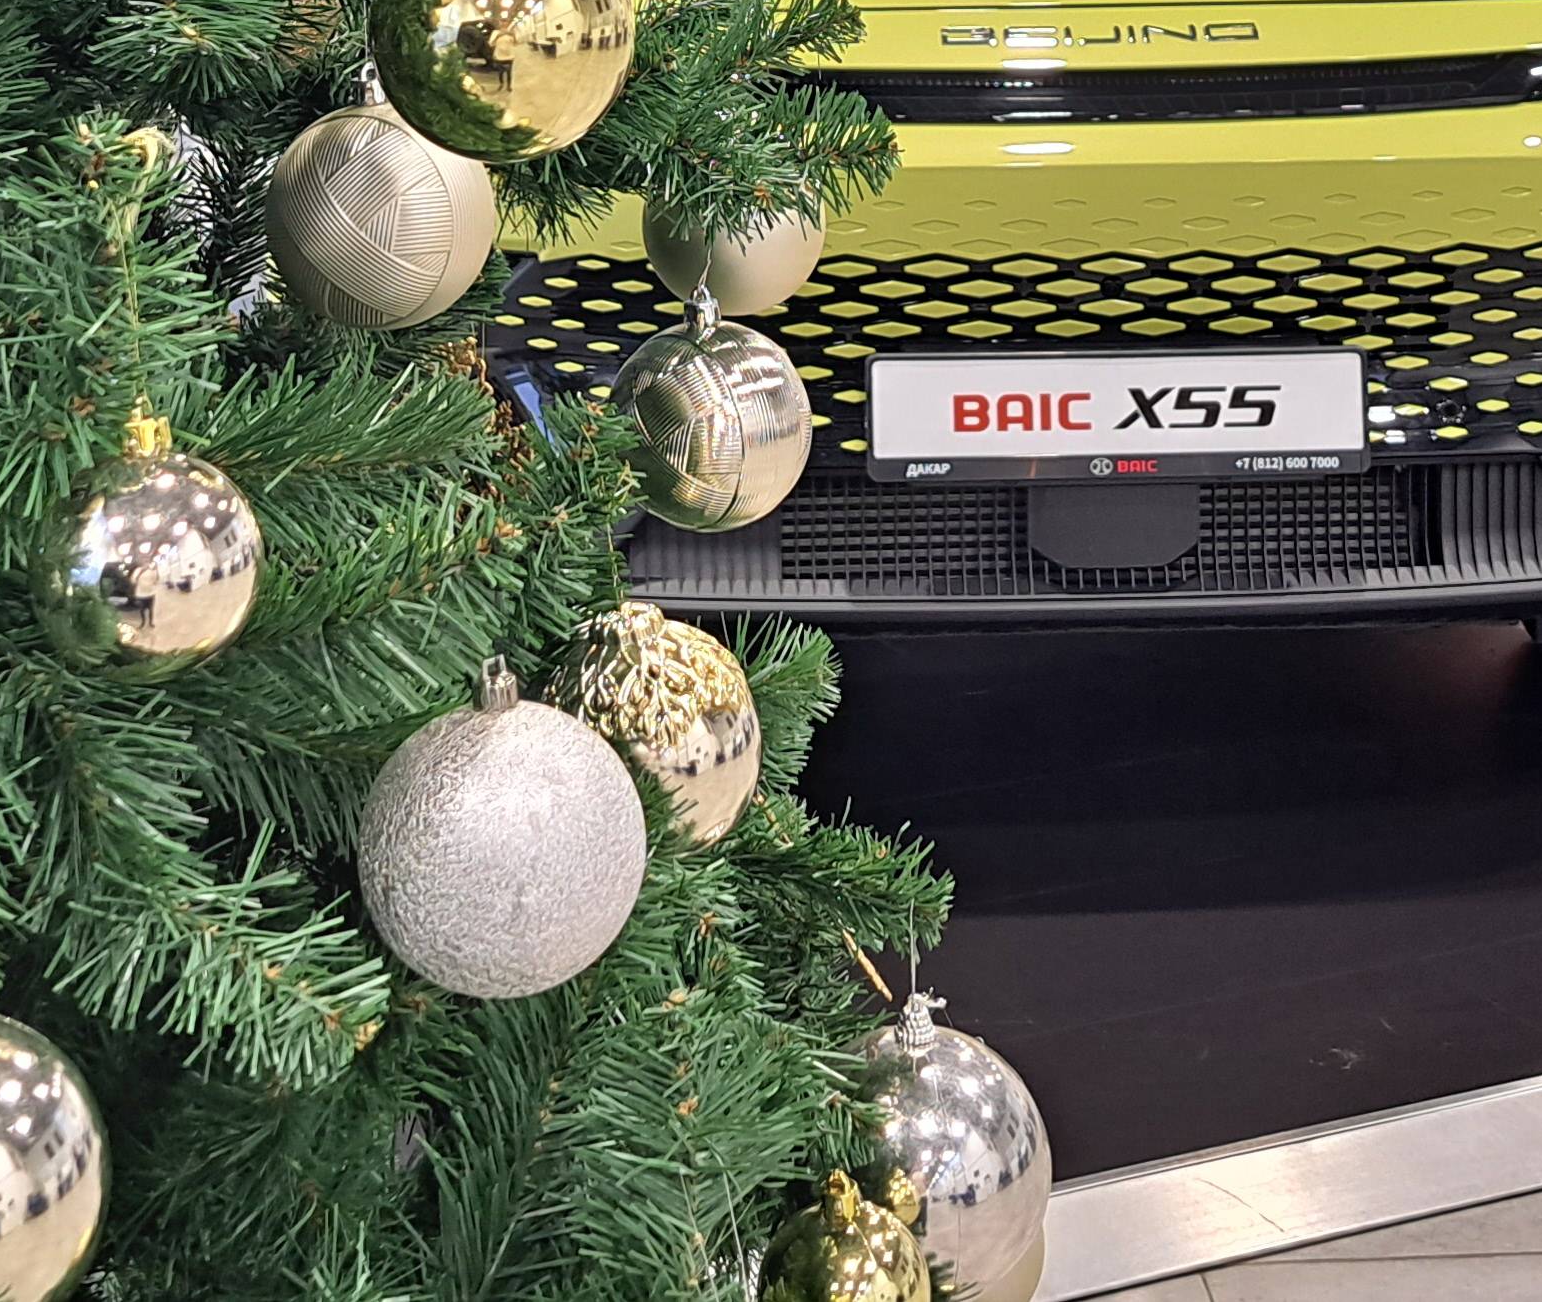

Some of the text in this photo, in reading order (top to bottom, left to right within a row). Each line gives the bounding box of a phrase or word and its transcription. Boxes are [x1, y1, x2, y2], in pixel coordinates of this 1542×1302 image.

[952, 385, 1282, 432] BAIC X55
[906, 462, 951, 478] ДАКАР
[1117, 460, 1158, 473] BAIC
[1235, 456, 1340, 471] +7 (812) 600 7000
